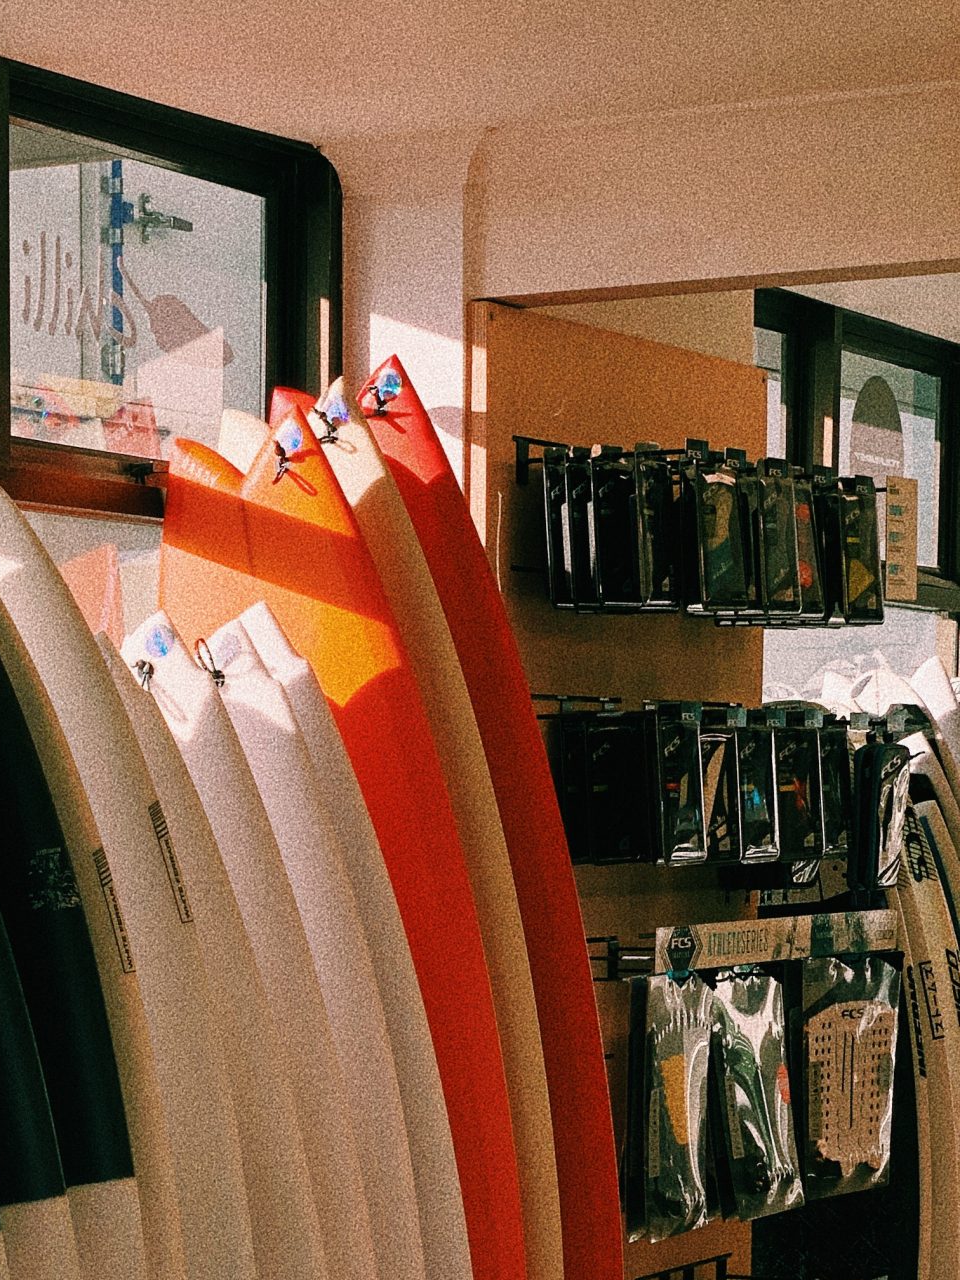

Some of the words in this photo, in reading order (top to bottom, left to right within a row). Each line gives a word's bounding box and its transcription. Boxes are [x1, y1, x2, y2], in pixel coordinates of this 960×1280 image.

[688, 450, 702, 459] FCS
[727, 458, 740, 468] FCS
[769, 467, 783, 477] FCS
[814, 474, 826, 484] FCS
[855, 484, 869, 494] FCS
[681, 712, 696, 721] FCS
[664, 735, 681, 758] FCS
[880, 755, 902, 780] FCS
[671, 937, 693, 949] FCS
